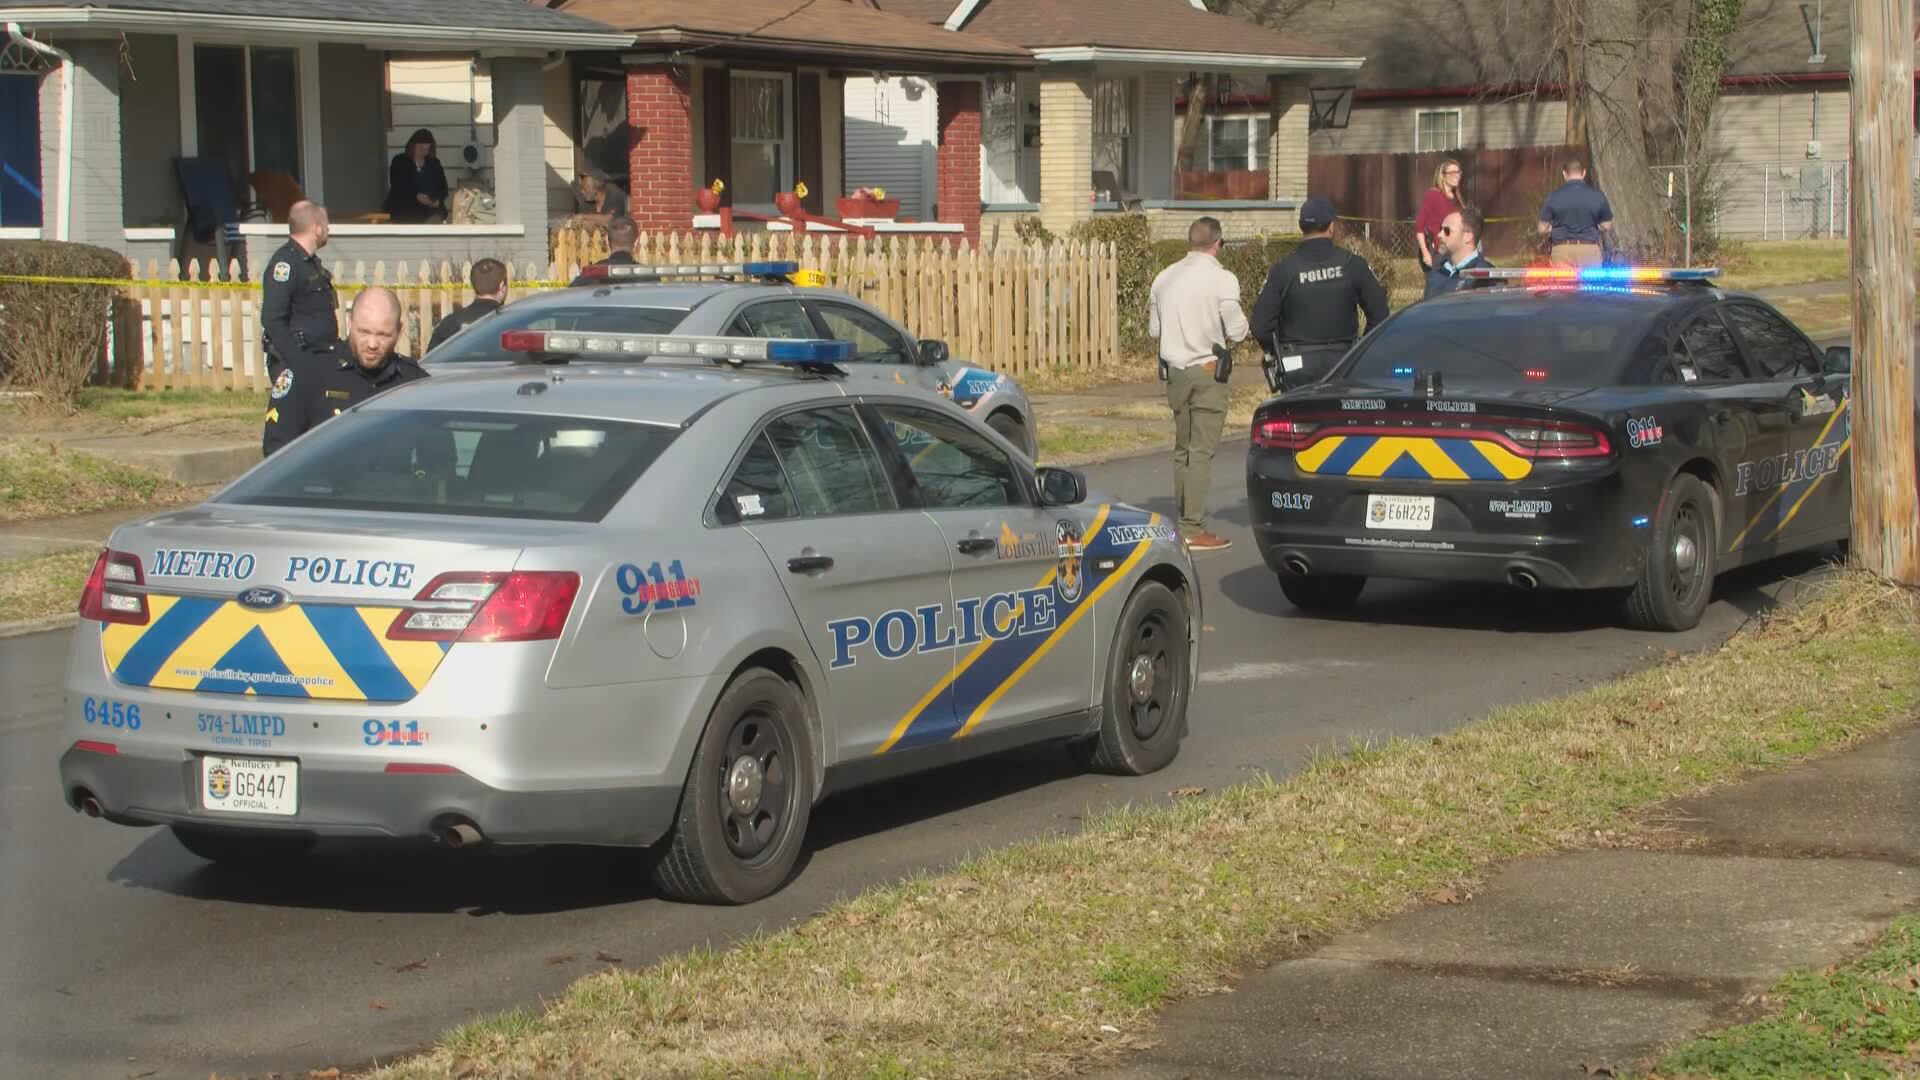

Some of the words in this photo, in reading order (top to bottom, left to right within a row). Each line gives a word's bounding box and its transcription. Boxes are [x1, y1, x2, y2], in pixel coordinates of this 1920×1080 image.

[1299, 265, 1343, 284] POLICE
[1341, 399, 1386, 410] METRO
[1426, 400, 1476, 413] POLICE
[1626, 415, 1661, 448] 911
[1735, 442, 1840, 496] POLICE
[1271, 492, 1312, 510] 8117
[1388, 504, 1431, 521] E6H225
[995, 529, 1055, 561] Louisville
[1110, 524, 1176, 545] METRO
[150, 550, 256, 580] METRO
[284, 556, 415, 589] POLICE
[244, 590, 277, 605] Ford
[616, 559, 696, 615] 911
[827, 585, 1056, 670] POLICE
[84, 697, 142, 730] 6456
[197, 712, 286, 736] 574-LMPD
[362, 719, 423, 746] 911
[231, 759, 272, 770] Kentucky
[236, 772, 286, 799] G6447
[233, 799, 268, 810] OFFICIAL
